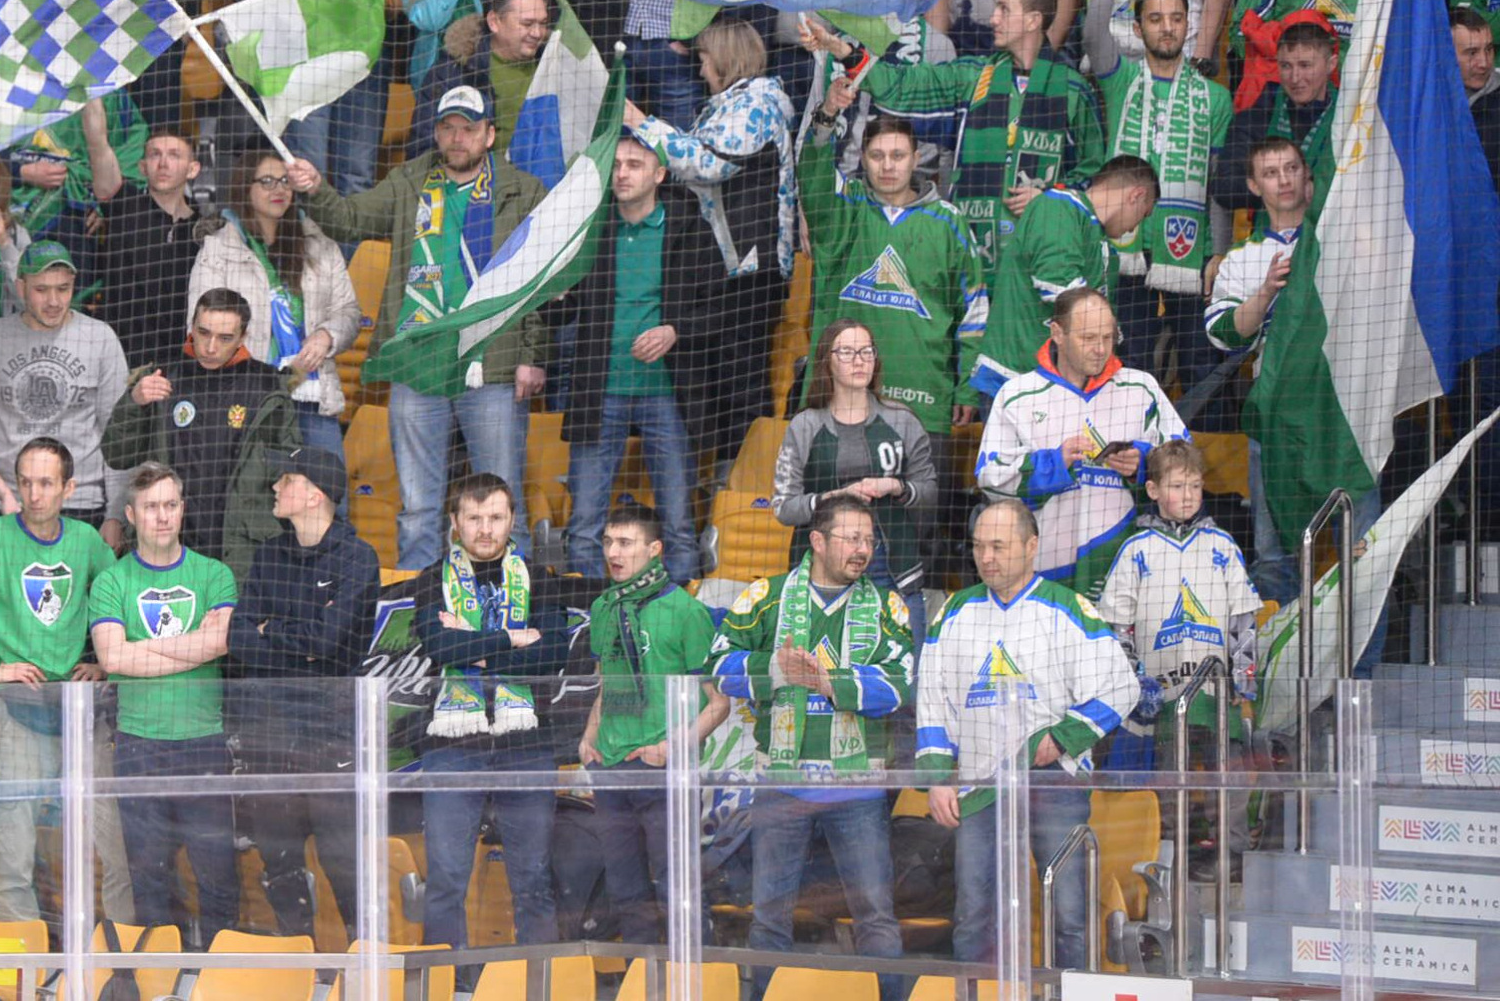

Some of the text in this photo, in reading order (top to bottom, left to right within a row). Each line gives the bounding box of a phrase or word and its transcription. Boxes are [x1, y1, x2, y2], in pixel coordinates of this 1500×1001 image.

[1022, 129, 1064, 152] УФА
[1, 344, 87, 379] LOS ANGELES
[881, 384, 936, 406] НЕФТЬ
[1467, 822, 1499, 833] ALM
[1424, 883, 1467, 895] ALMA
[1423, 895, 1500, 909] CERAMIC
[1382, 945, 1426, 957] ALMA
[1382, 957, 1470, 973] CERAMICA
